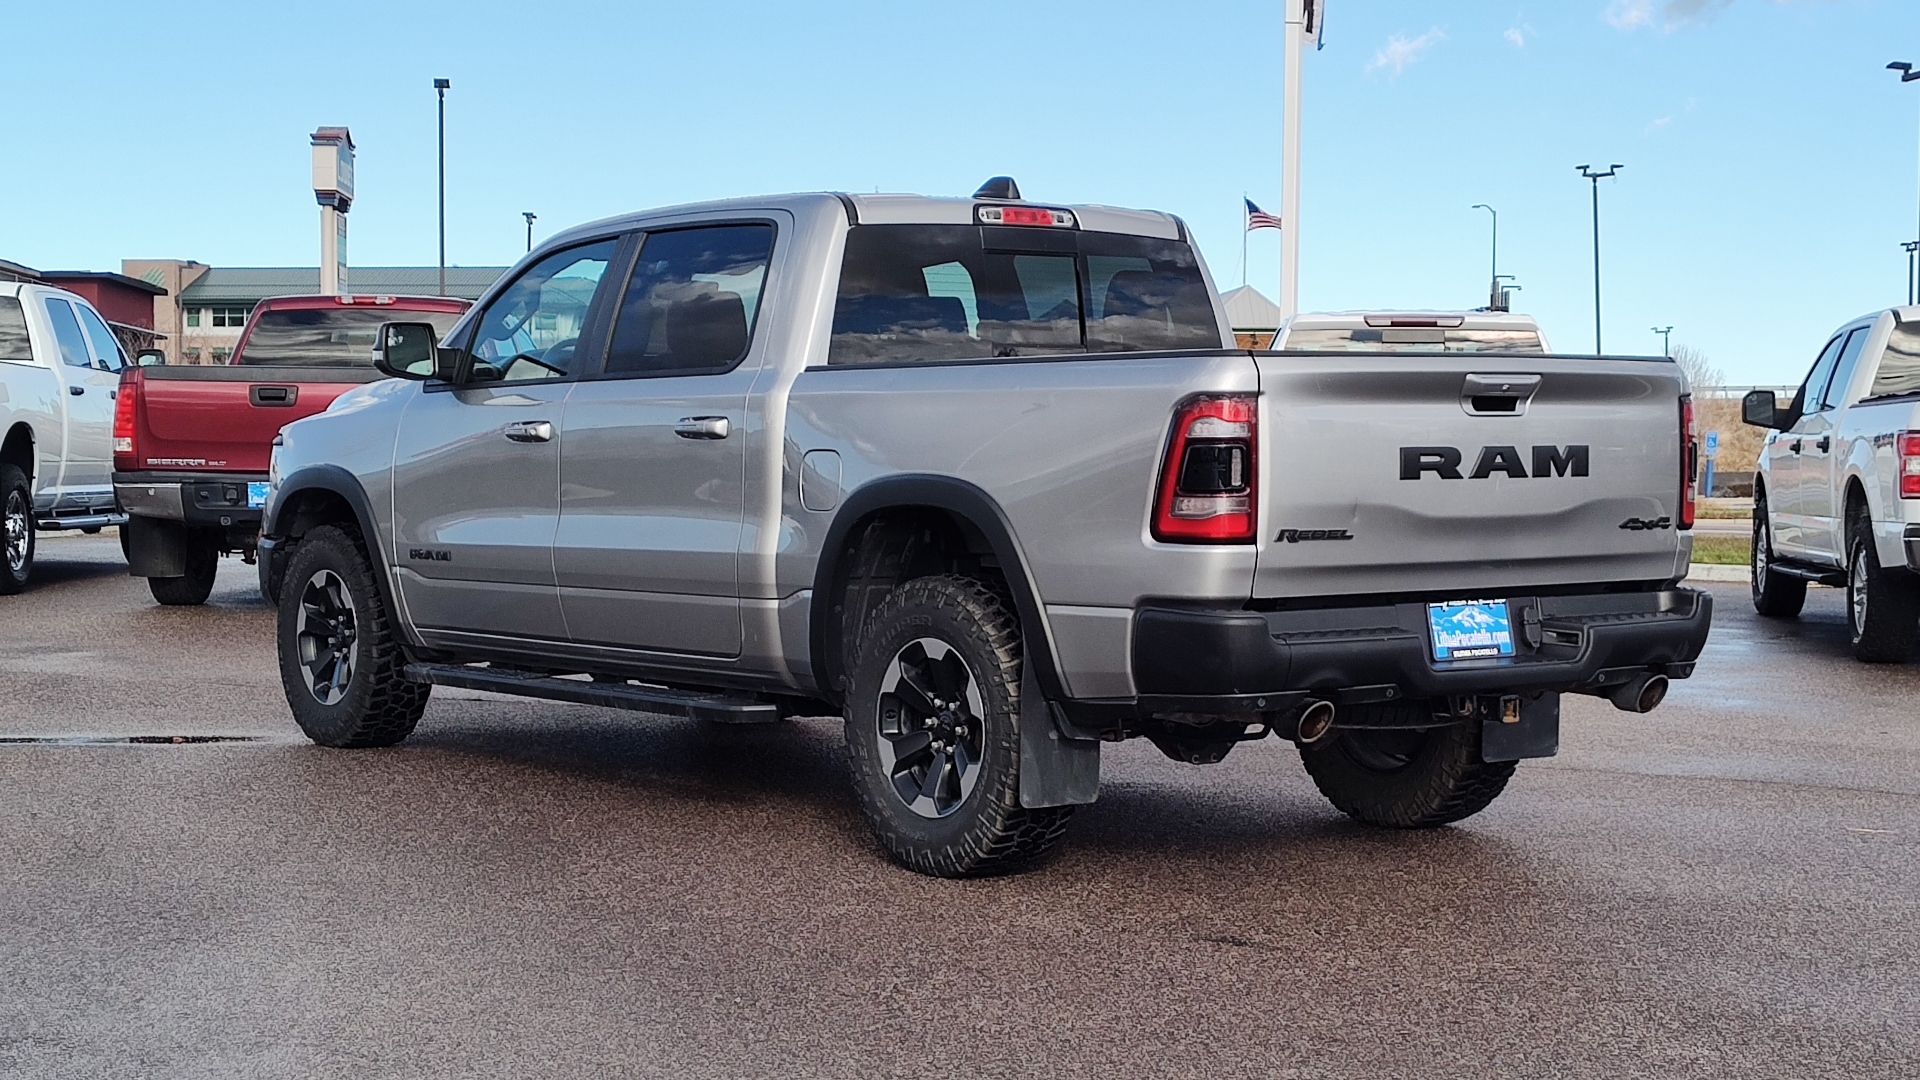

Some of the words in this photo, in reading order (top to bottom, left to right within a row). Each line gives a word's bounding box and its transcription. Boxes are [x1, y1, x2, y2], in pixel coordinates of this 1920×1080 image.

[146, 458, 206, 466] SIERRA
[1399, 445, 1589, 480] RAM
[409, 549, 451, 561] RAM
